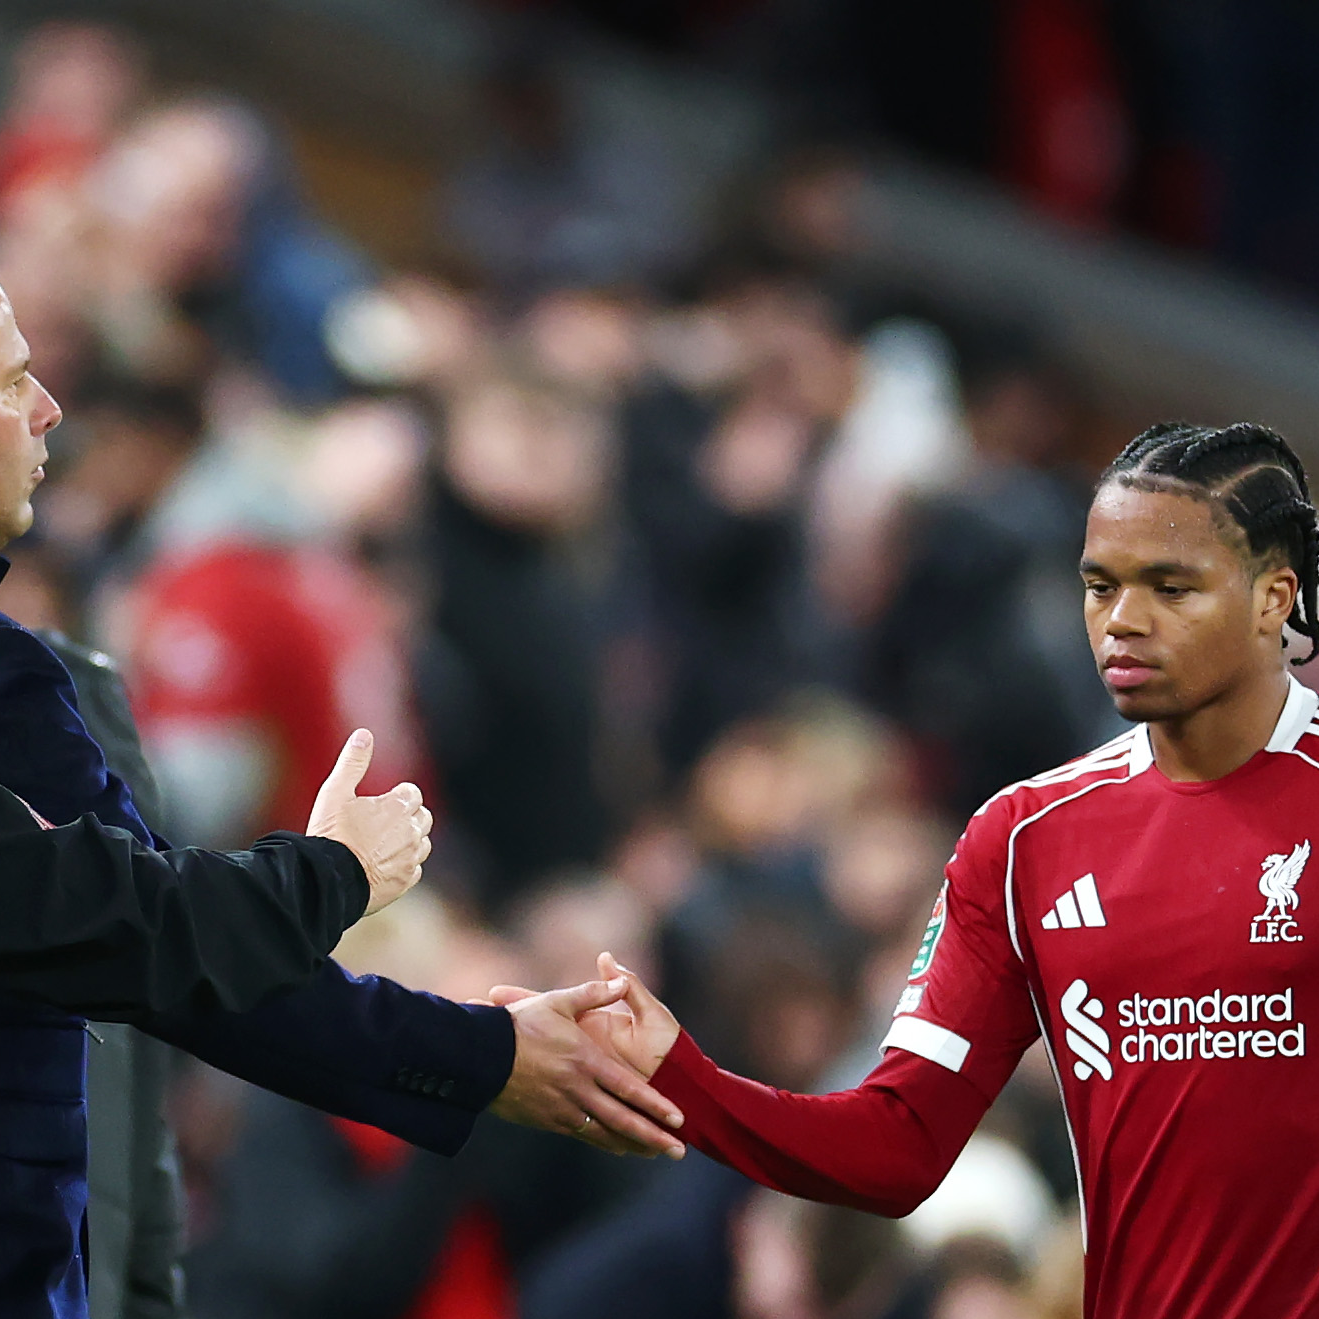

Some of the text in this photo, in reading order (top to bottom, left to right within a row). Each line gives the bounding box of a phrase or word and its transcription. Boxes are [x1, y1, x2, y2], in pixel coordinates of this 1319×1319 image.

[1250, 922, 1303, 943] L.F.C.
[1118, 988, 1293, 1028] standard
[1121, 1023, 1306, 1063] chartered
